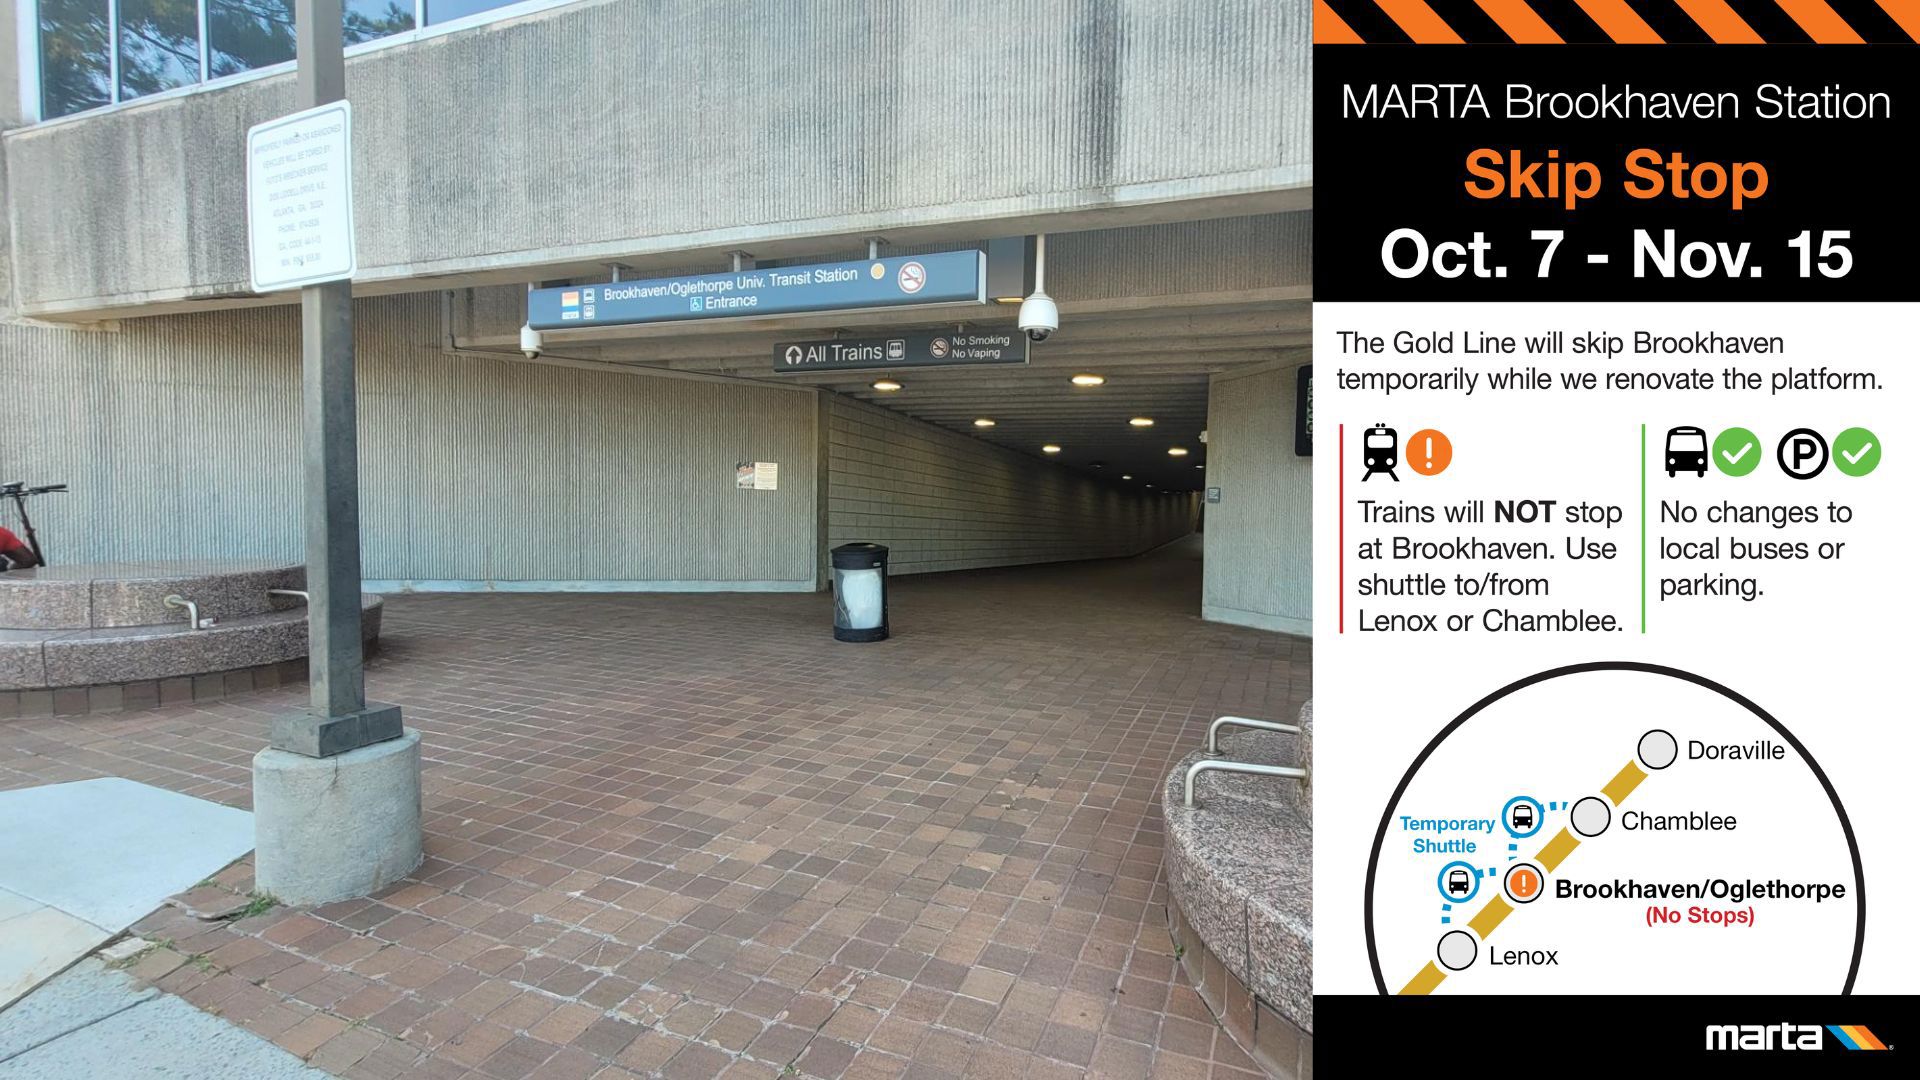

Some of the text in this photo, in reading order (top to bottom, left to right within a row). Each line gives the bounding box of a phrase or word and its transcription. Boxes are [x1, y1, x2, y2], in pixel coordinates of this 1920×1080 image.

[604, 268, 858, 301] Brookhaven/Oglethorpe Univ. Transit Station
[705, 295, 757, 309] Entrance
[952, 335, 1010, 346] No Smoking
[806, 345, 883, 363] All Trains
[952, 348, 1001, 359] No Vaping
